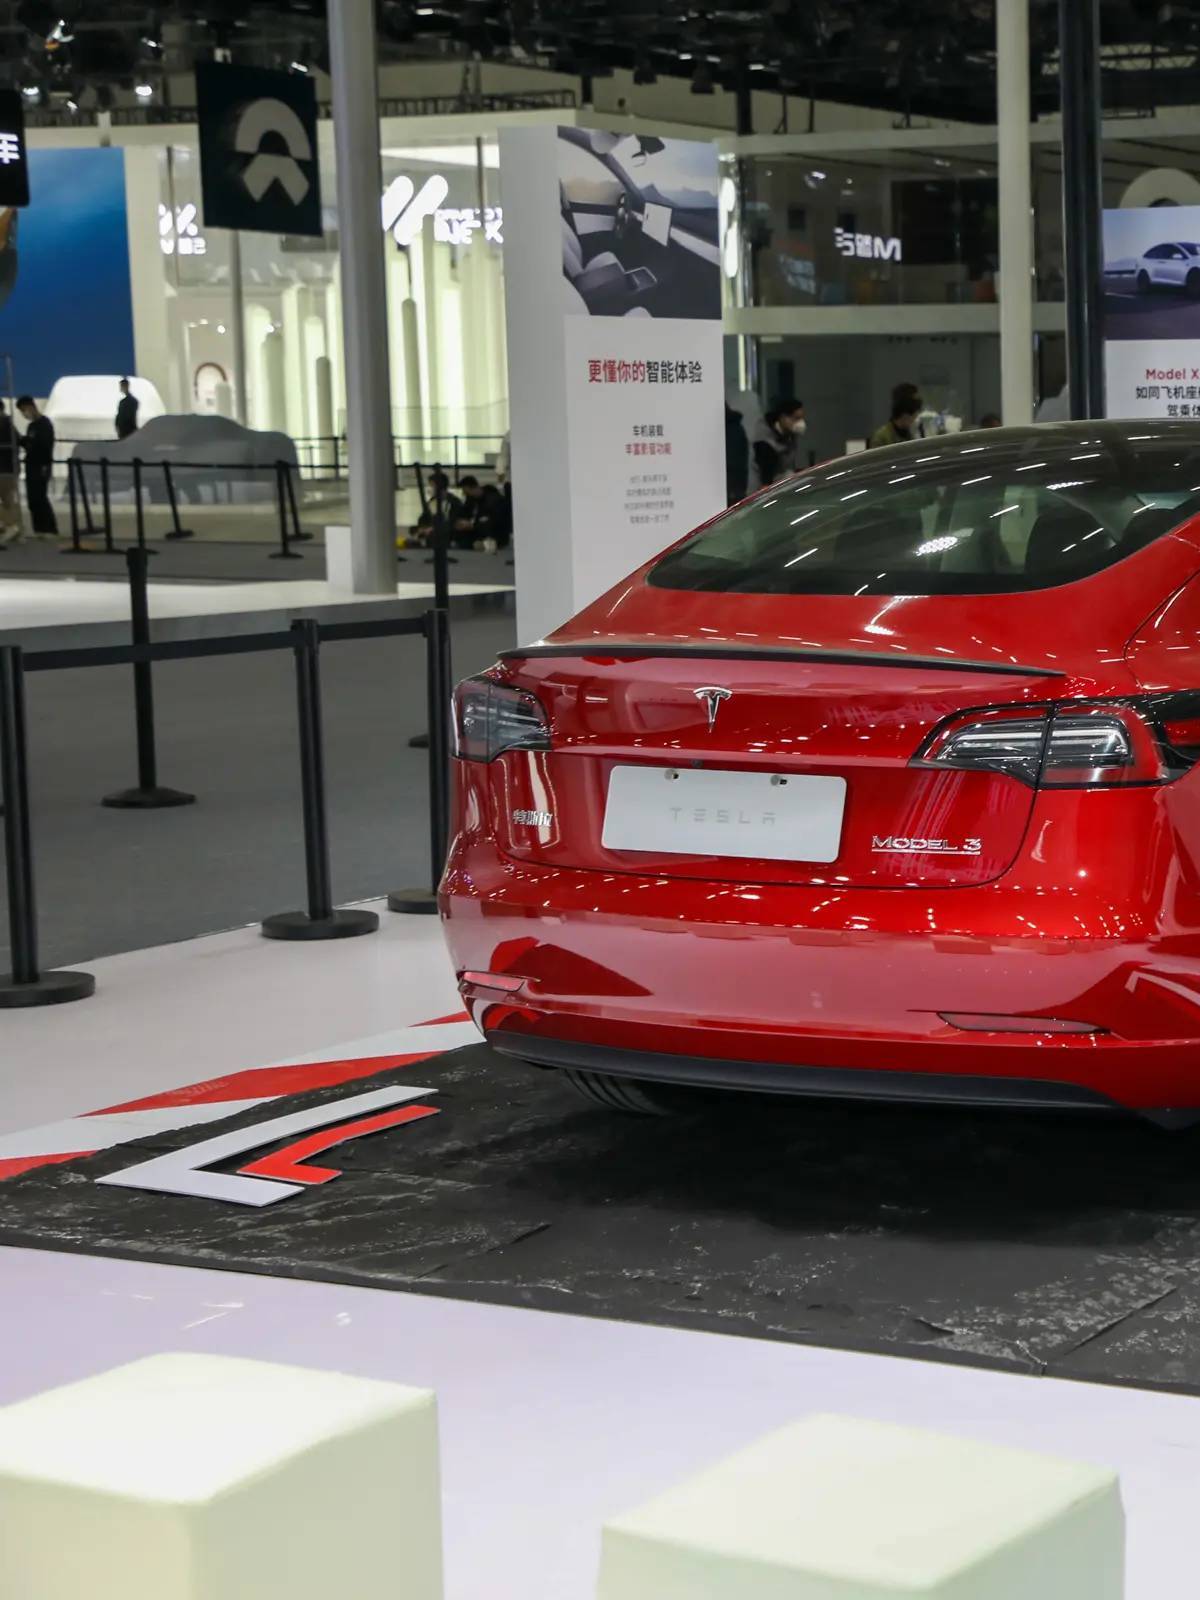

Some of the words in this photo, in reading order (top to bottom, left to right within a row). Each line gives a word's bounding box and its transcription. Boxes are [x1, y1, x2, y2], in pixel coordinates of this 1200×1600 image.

[588, 360, 703, 383] 更懂你的智能体验
[1145, 368, 1187, 381] Model
[1191, 368, 1200, 380] X
[669, 807, 776, 825] TESLA
[872, 835, 959, 851] MODEL
[963, 838, 982, 851] 3
